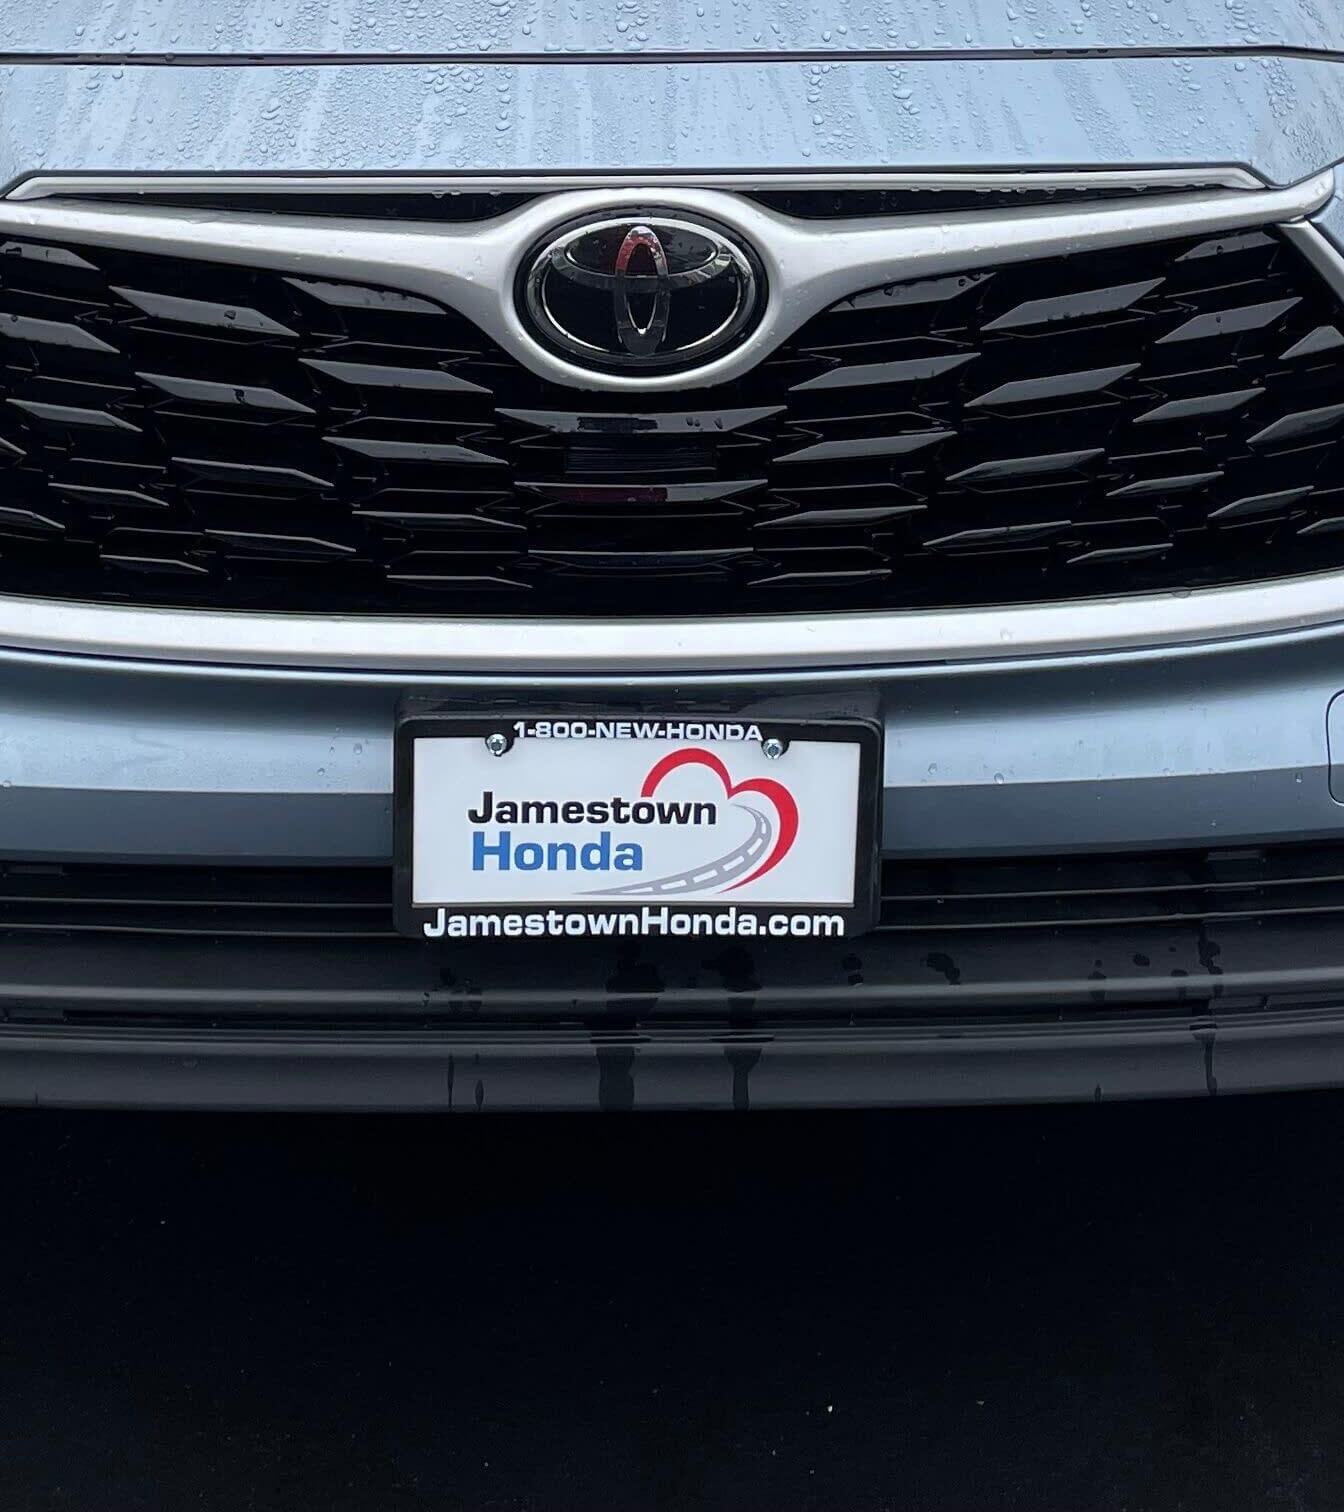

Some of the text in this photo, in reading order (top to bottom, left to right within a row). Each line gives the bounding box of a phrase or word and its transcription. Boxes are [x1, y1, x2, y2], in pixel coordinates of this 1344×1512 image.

[513, 721, 764, 742] 1-800-NEW-HONDA
[467, 790, 717, 826] Jamestown
[471, 830, 644, 872] Honda
[423, 906, 846, 938] JamestownHonda.com
